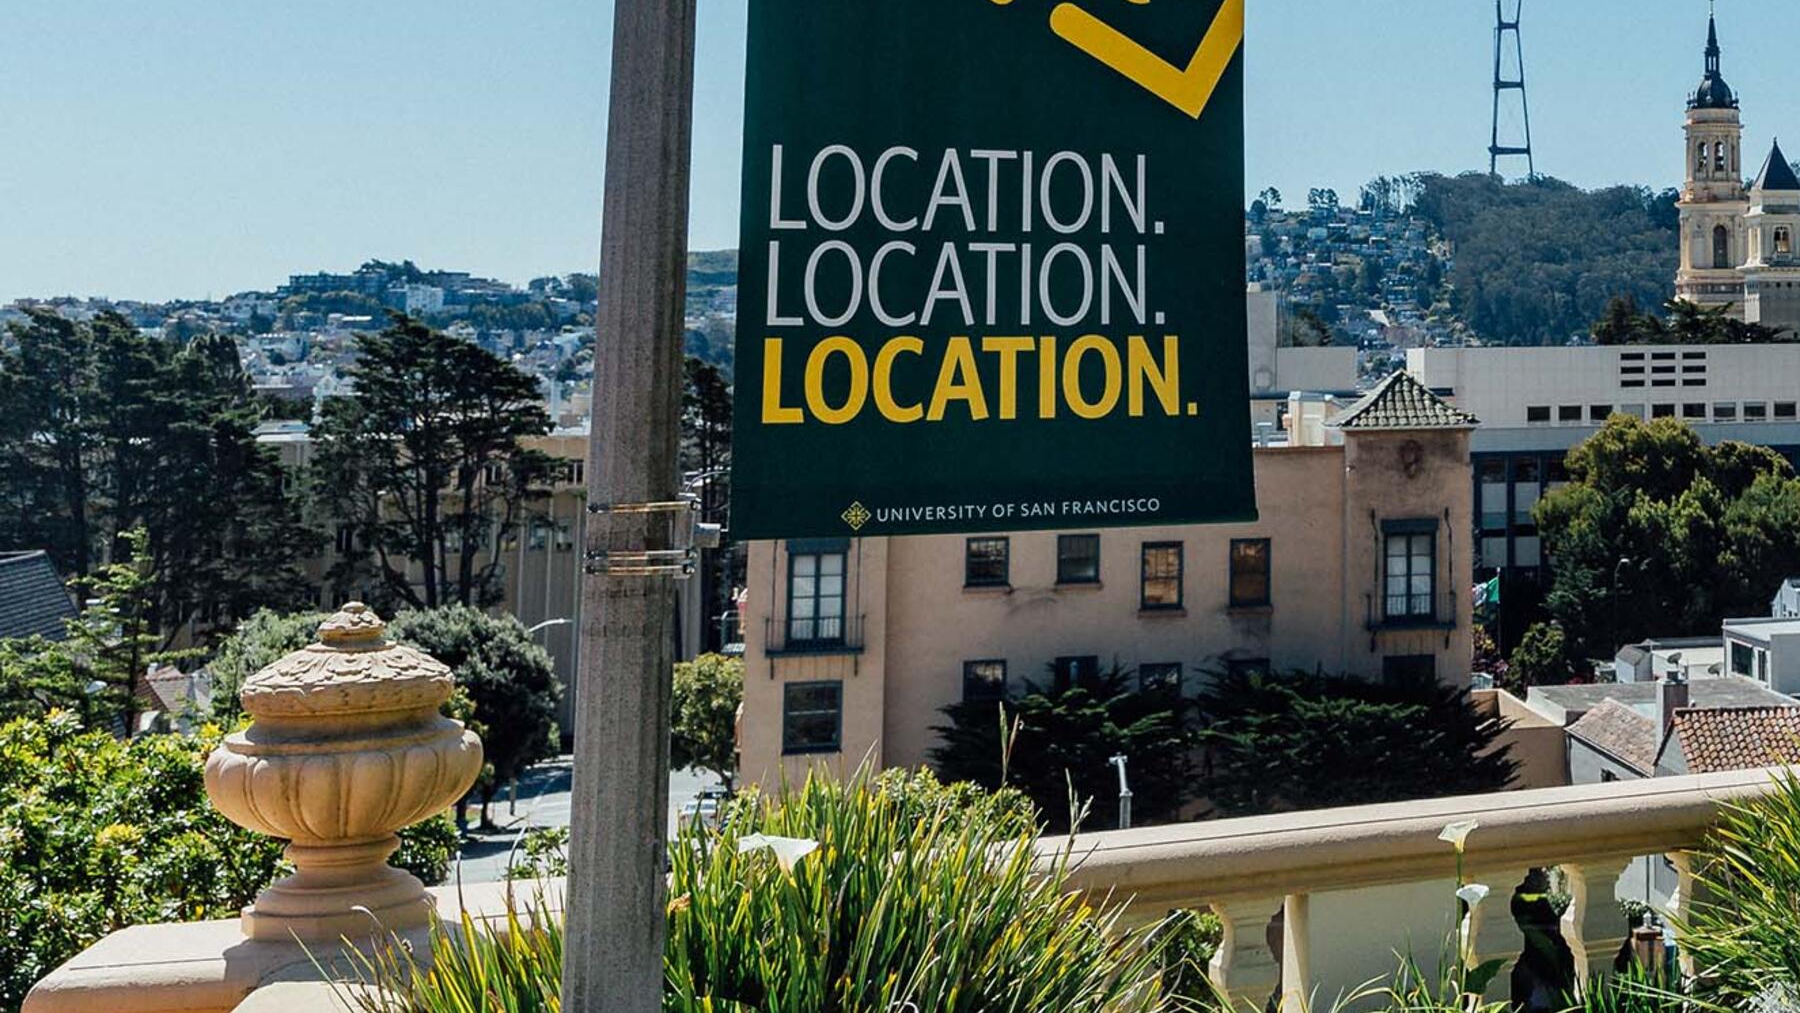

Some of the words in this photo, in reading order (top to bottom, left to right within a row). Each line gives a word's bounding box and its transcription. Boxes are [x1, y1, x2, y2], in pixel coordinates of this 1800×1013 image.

[769, 144, 1164, 234] LOCATION.
[766, 240, 1165, 327] LOCATION.
[761, 334, 1198, 425] LOCATION.
[876, 504, 987, 523] UNIVERSITY
[991, 503, 1015, 519] OF
[1019, 501, 1056, 517] SAN
[1061, 497, 1161, 515] FRANCISCO
